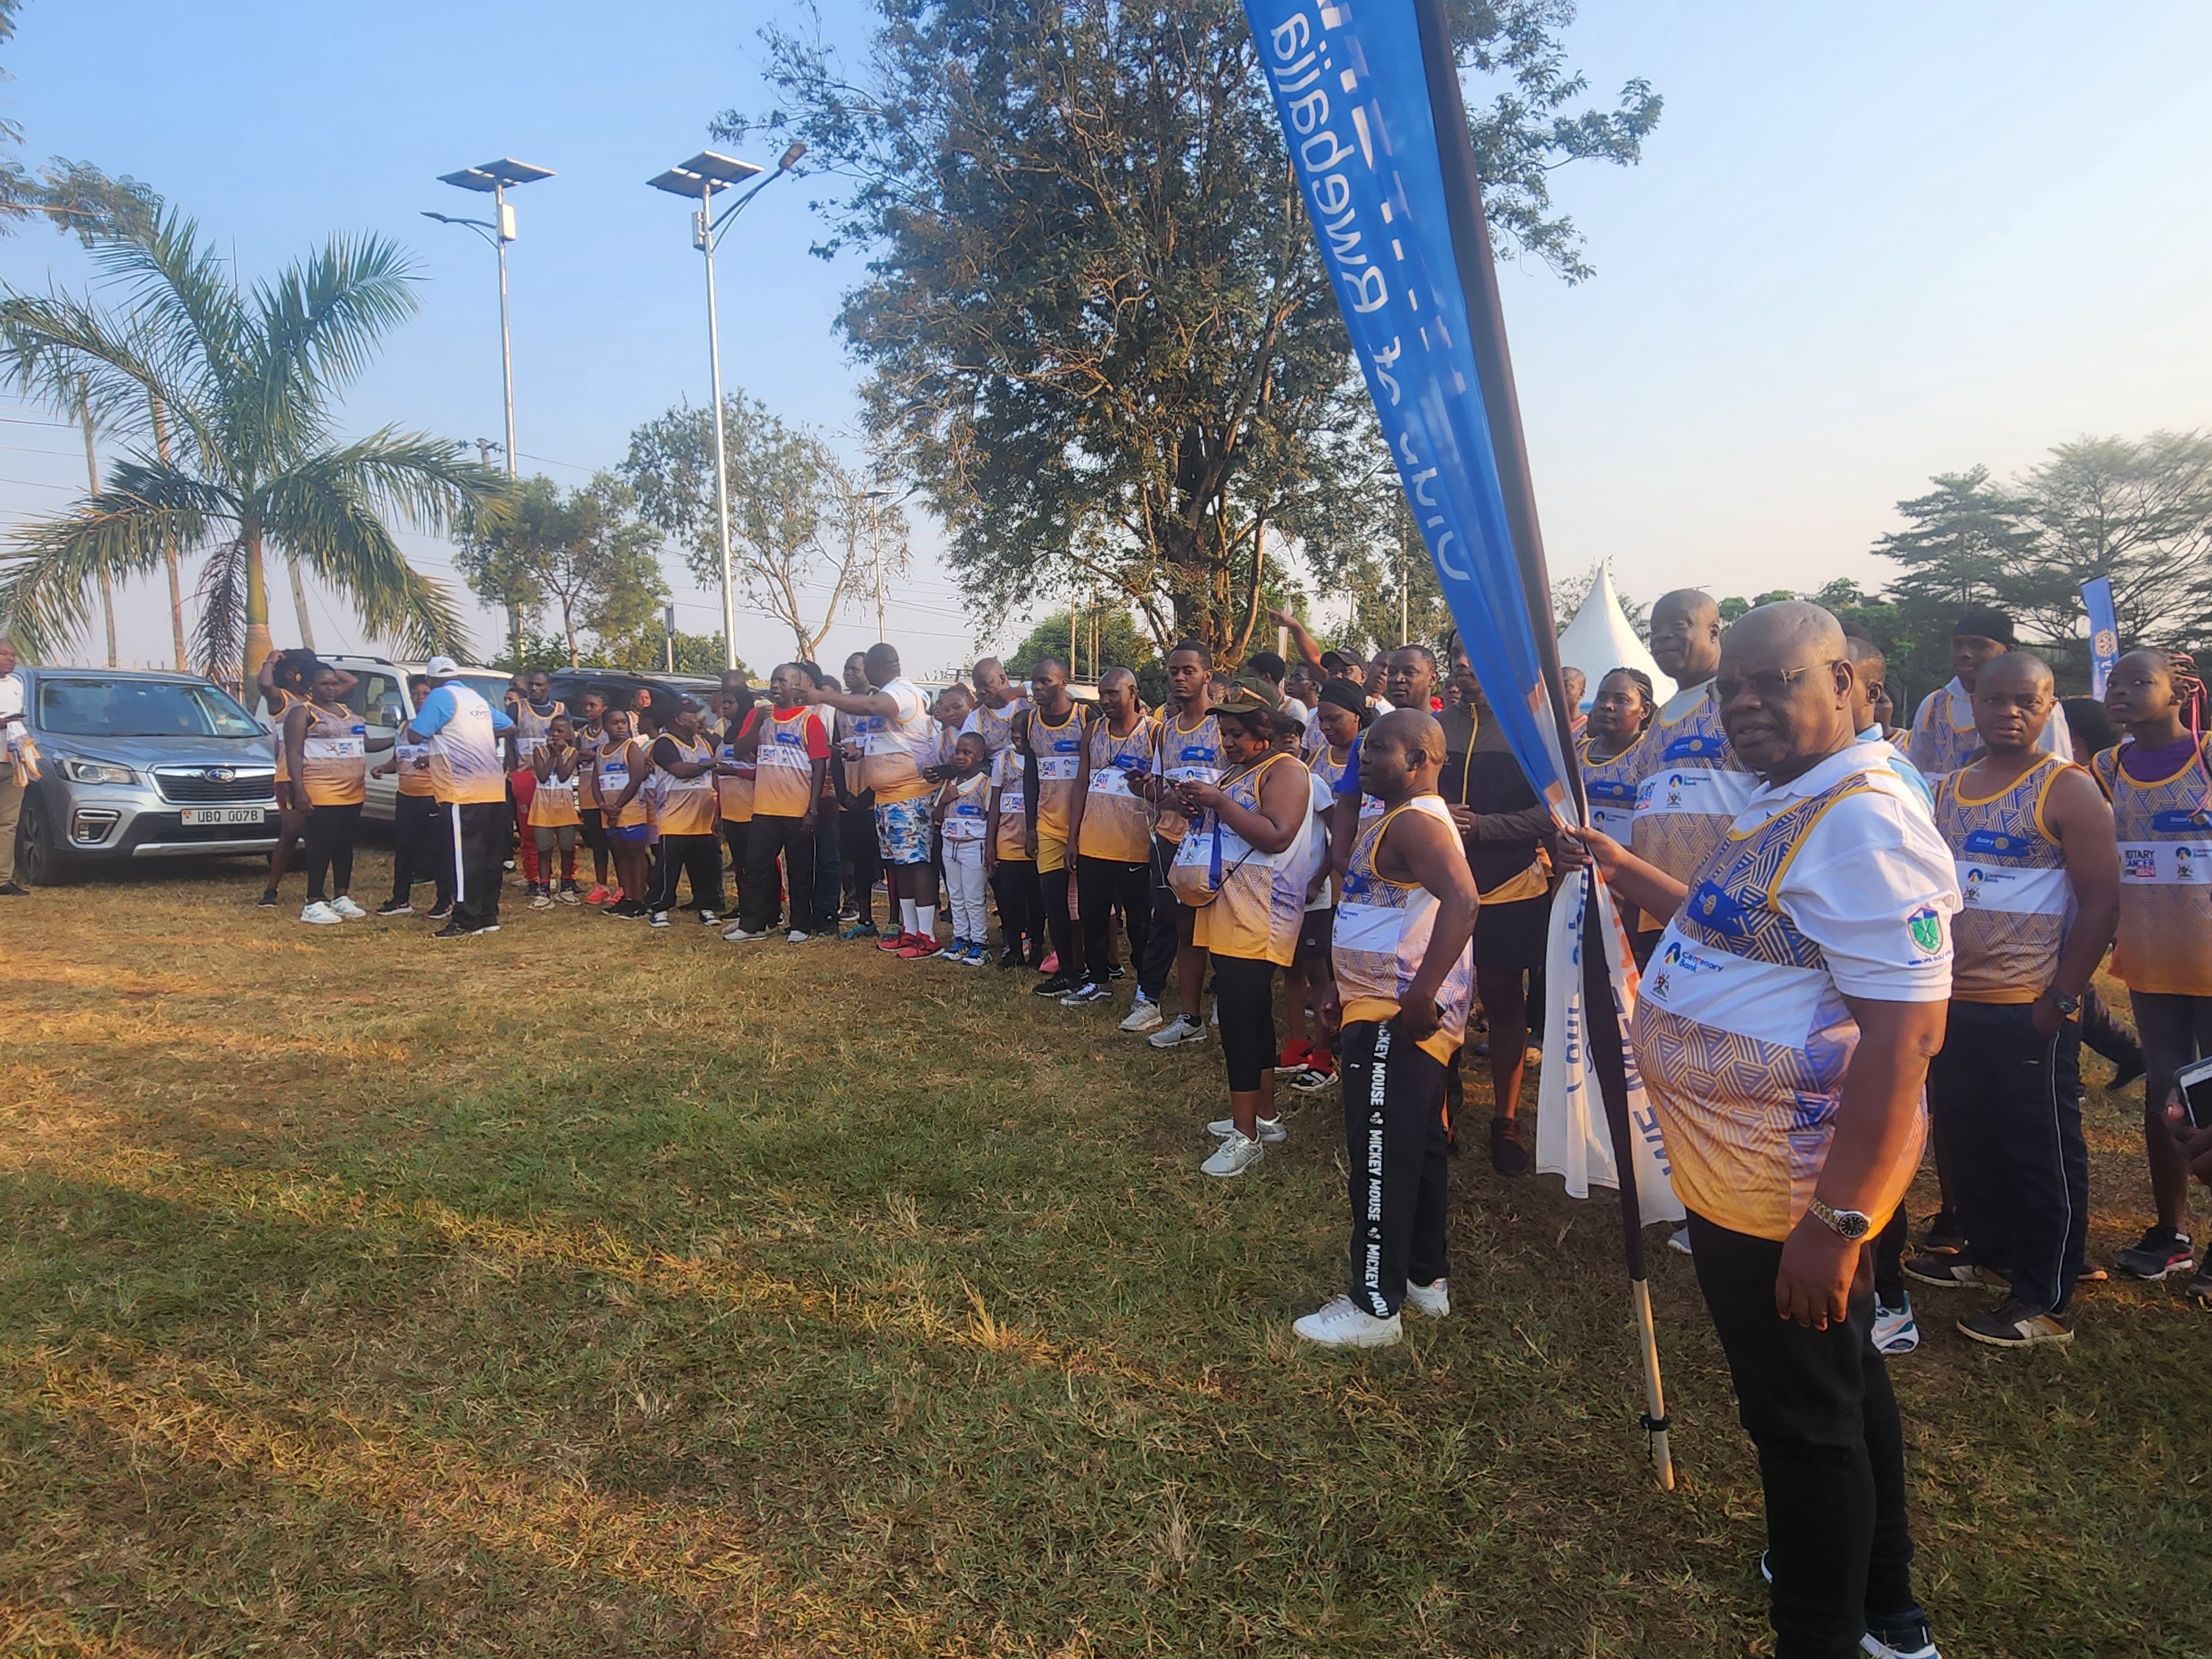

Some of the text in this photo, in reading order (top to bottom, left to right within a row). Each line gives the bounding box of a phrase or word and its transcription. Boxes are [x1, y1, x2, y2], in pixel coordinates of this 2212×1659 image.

[198, 810, 258, 822] UBQ 007B
[1976, 837, 1995, 845] Rotary
[1679, 960, 1698, 973] Bank
[1682, 951, 1724, 973] Centenary
[1365, 1021, 1391, 1317] CKEY MOUSE MICKEY MOUSE MICKEY MOU
